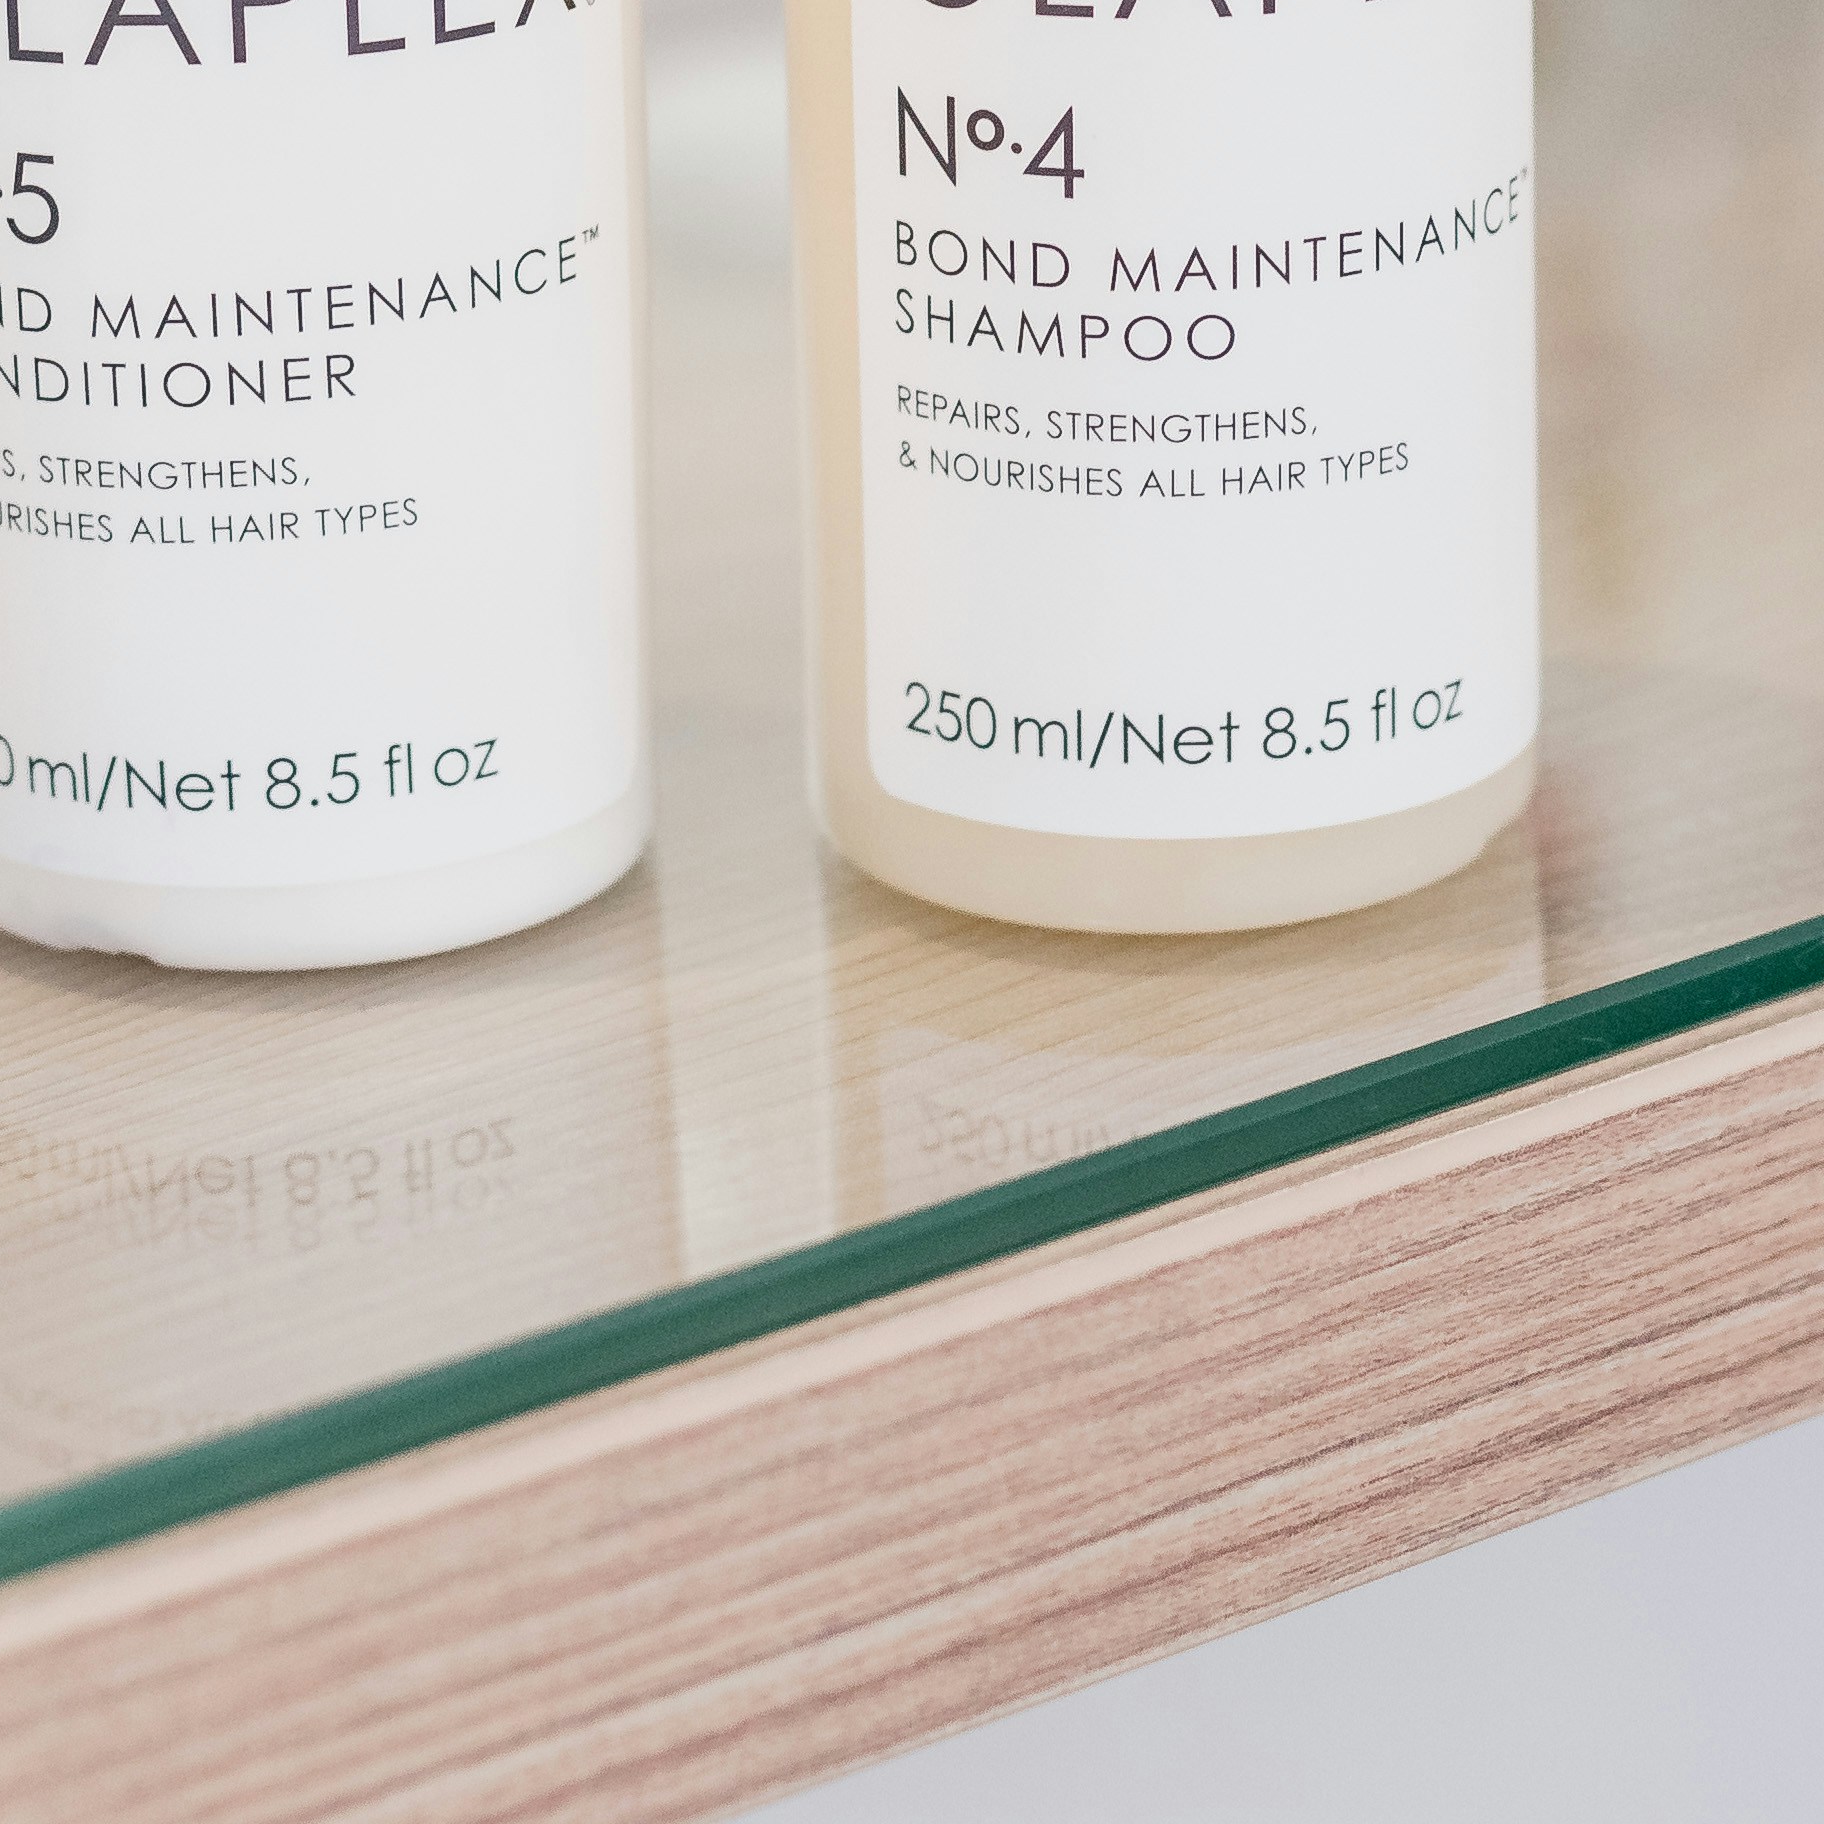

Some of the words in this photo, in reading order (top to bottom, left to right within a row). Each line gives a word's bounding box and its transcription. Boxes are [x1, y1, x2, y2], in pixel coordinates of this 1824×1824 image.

[896, 219, 1070, 288] BOND
[895, 289, 1238, 362] SHAMPOO
[897, 384, 1031, 438] REPAIRS,
[1046, 406, 1317, 444] STRENGTHENS,
[39, 455, 310, 490] STRENGTHENS,
[899, 440, 917, 470] &
[930, 446, 1123, 497] NOURISHES
[1139, 469, 1205, 498] ALL
[1222, 461, 1306, 496] HAIR
[1320, 442, 1409, 485] TYPES
[130, 516, 195, 544] ALL
[211, 512, 299, 544] HAIR
[314, 497, 418, 537] TYPES
[905, 681, 997, 750] 250
[1013, 709, 1240, 769] ml/Net
[1262, 698, 1351, 760] 8.5
[1370, 686, 1396, 743] fl
[1412, 678, 1463, 731] oz
[27, 752, 241, 812] ml/Net
[265, 752, 360, 810] 8.5
[383, 742, 414, 797] fl
[433, 738, 499, 788] oz
